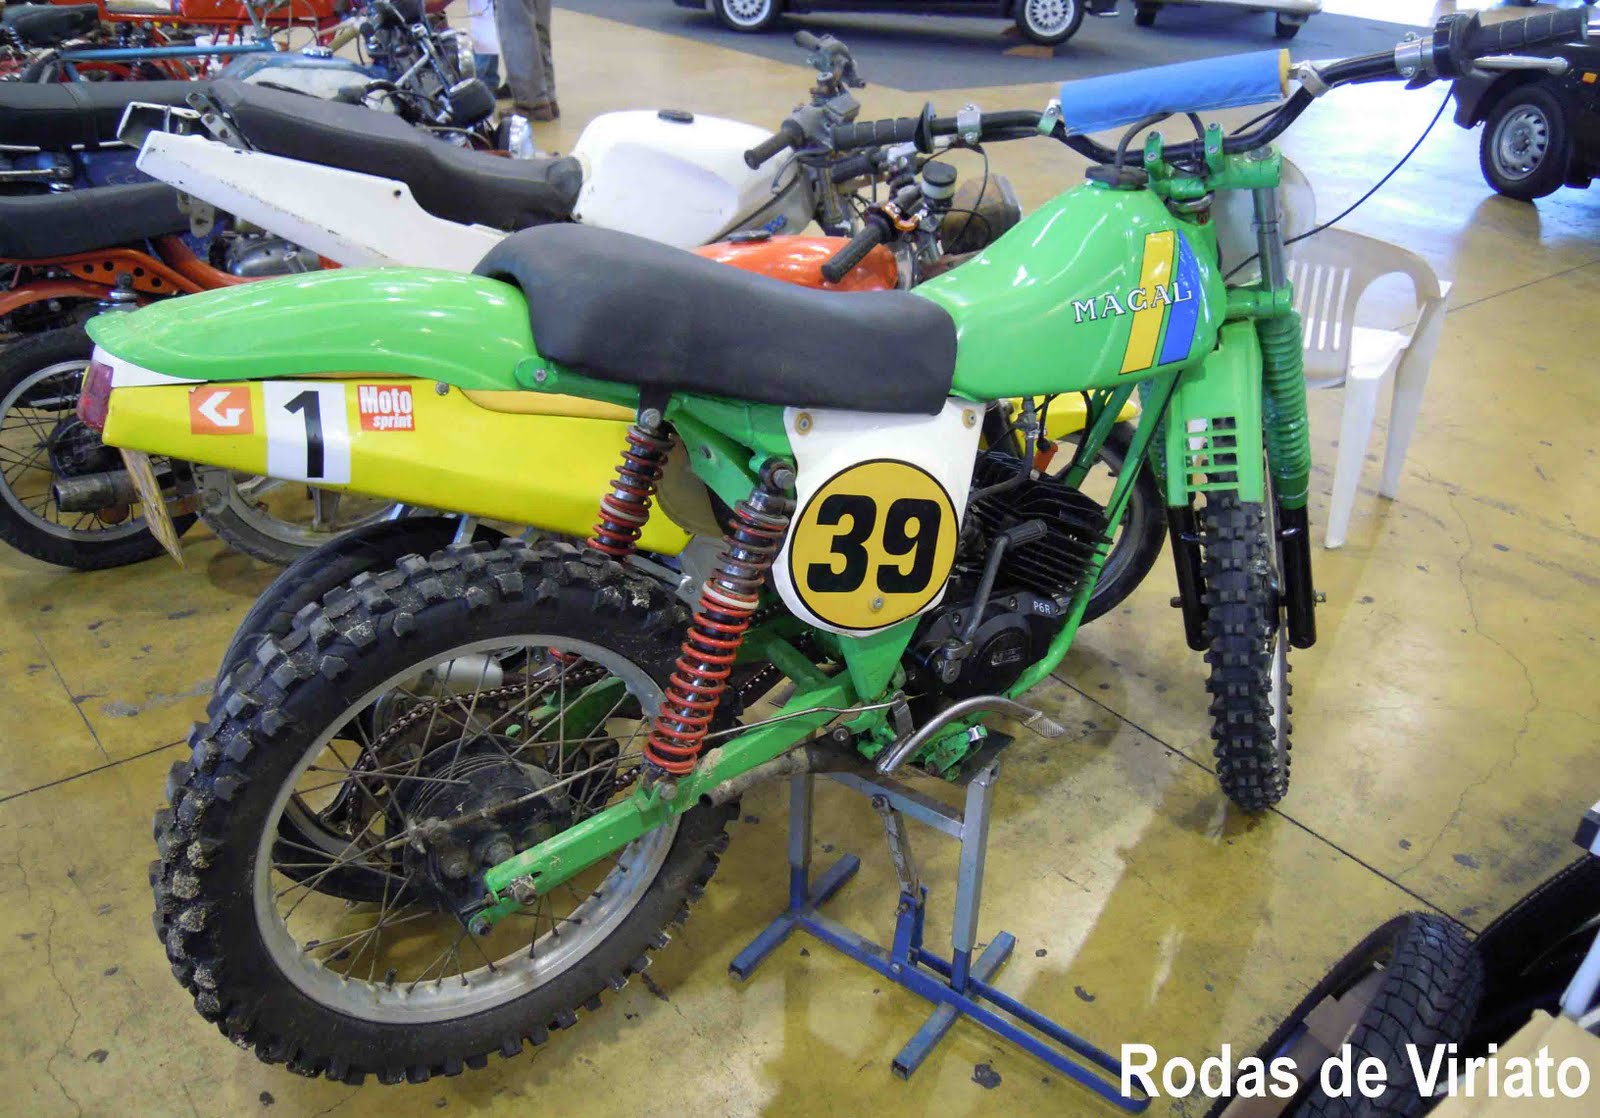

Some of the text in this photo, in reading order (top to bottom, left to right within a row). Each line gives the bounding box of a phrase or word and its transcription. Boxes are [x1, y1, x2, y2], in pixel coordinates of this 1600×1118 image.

[1071, 281, 1193, 324] MACAL
[359, 386, 413, 414] Moto
[283, 390, 324, 478] 1
[373, 414, 413, 430] sprint
[806, 493, 942, 594] 39
[1033, 600, 1051, 615] P6R
